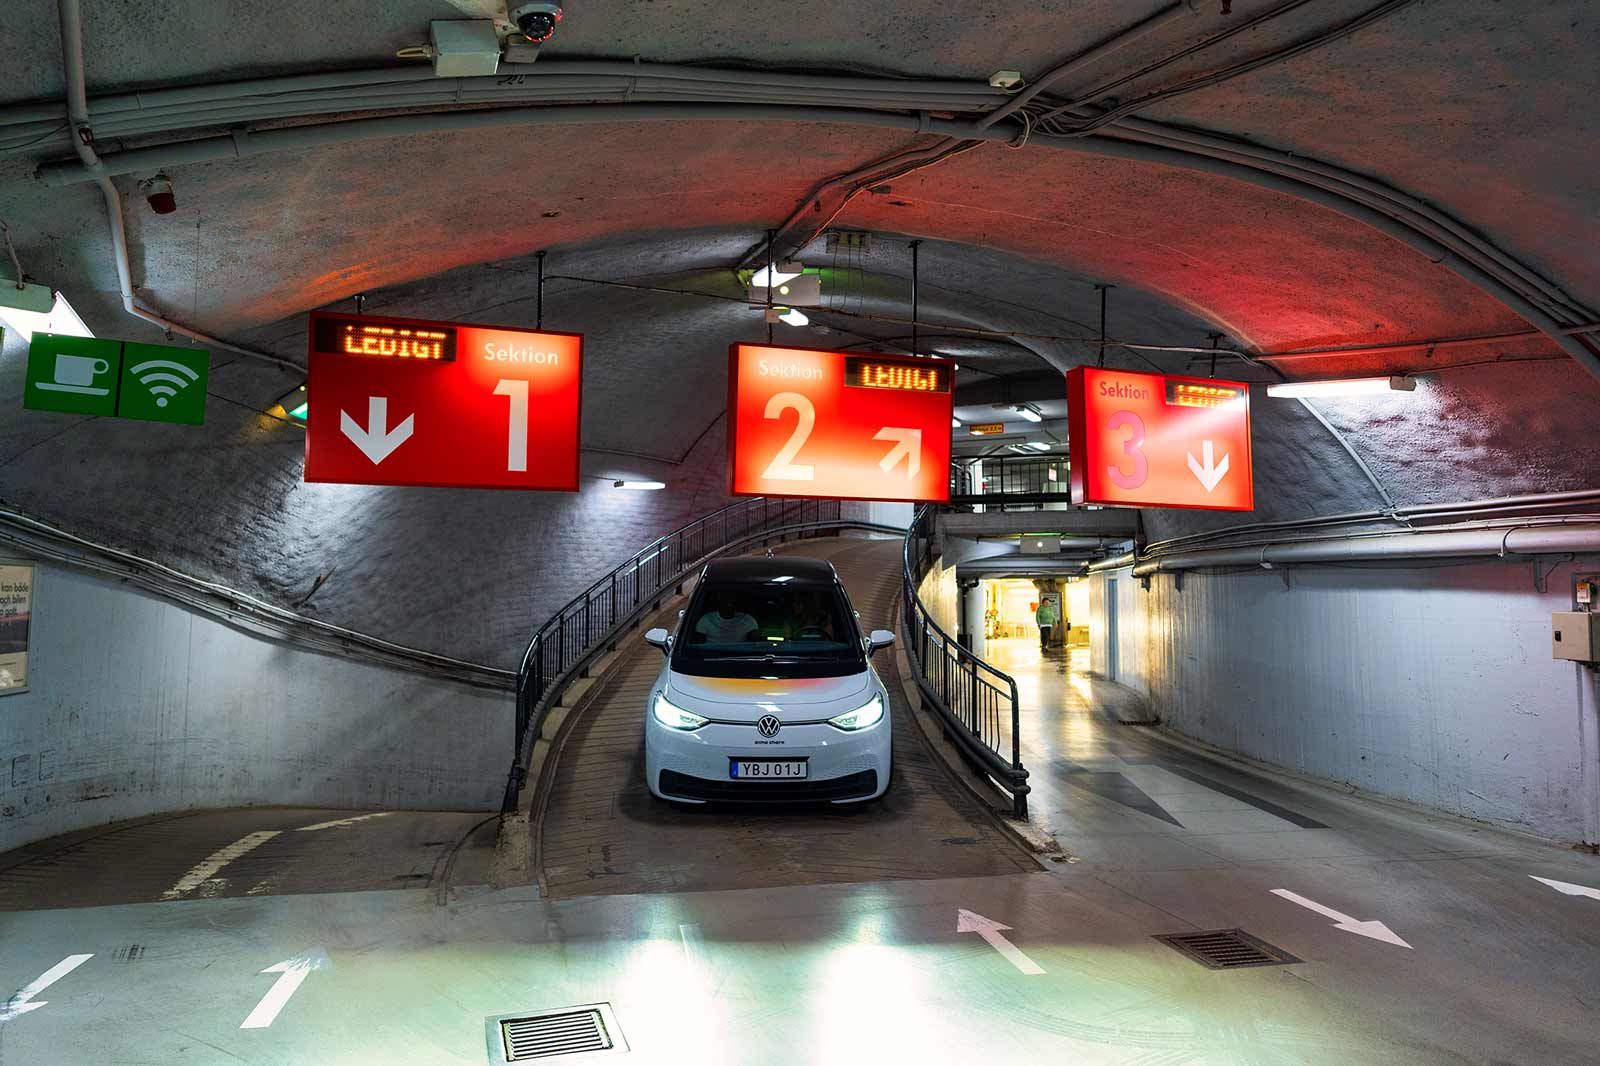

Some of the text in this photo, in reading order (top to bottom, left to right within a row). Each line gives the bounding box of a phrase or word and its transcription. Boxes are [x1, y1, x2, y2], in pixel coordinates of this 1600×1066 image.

[484, 342, 559, 366] Sektion
[759, 359, 823, 380] Sektion
[1100, 380, 1150, 400] Sektion
[492, 378, 529, 472] 1
[761, 392, 816, 481] 2
[1106, 410, 1149, 490] 3
[743, 763, 801, 776] YBJ 01J
